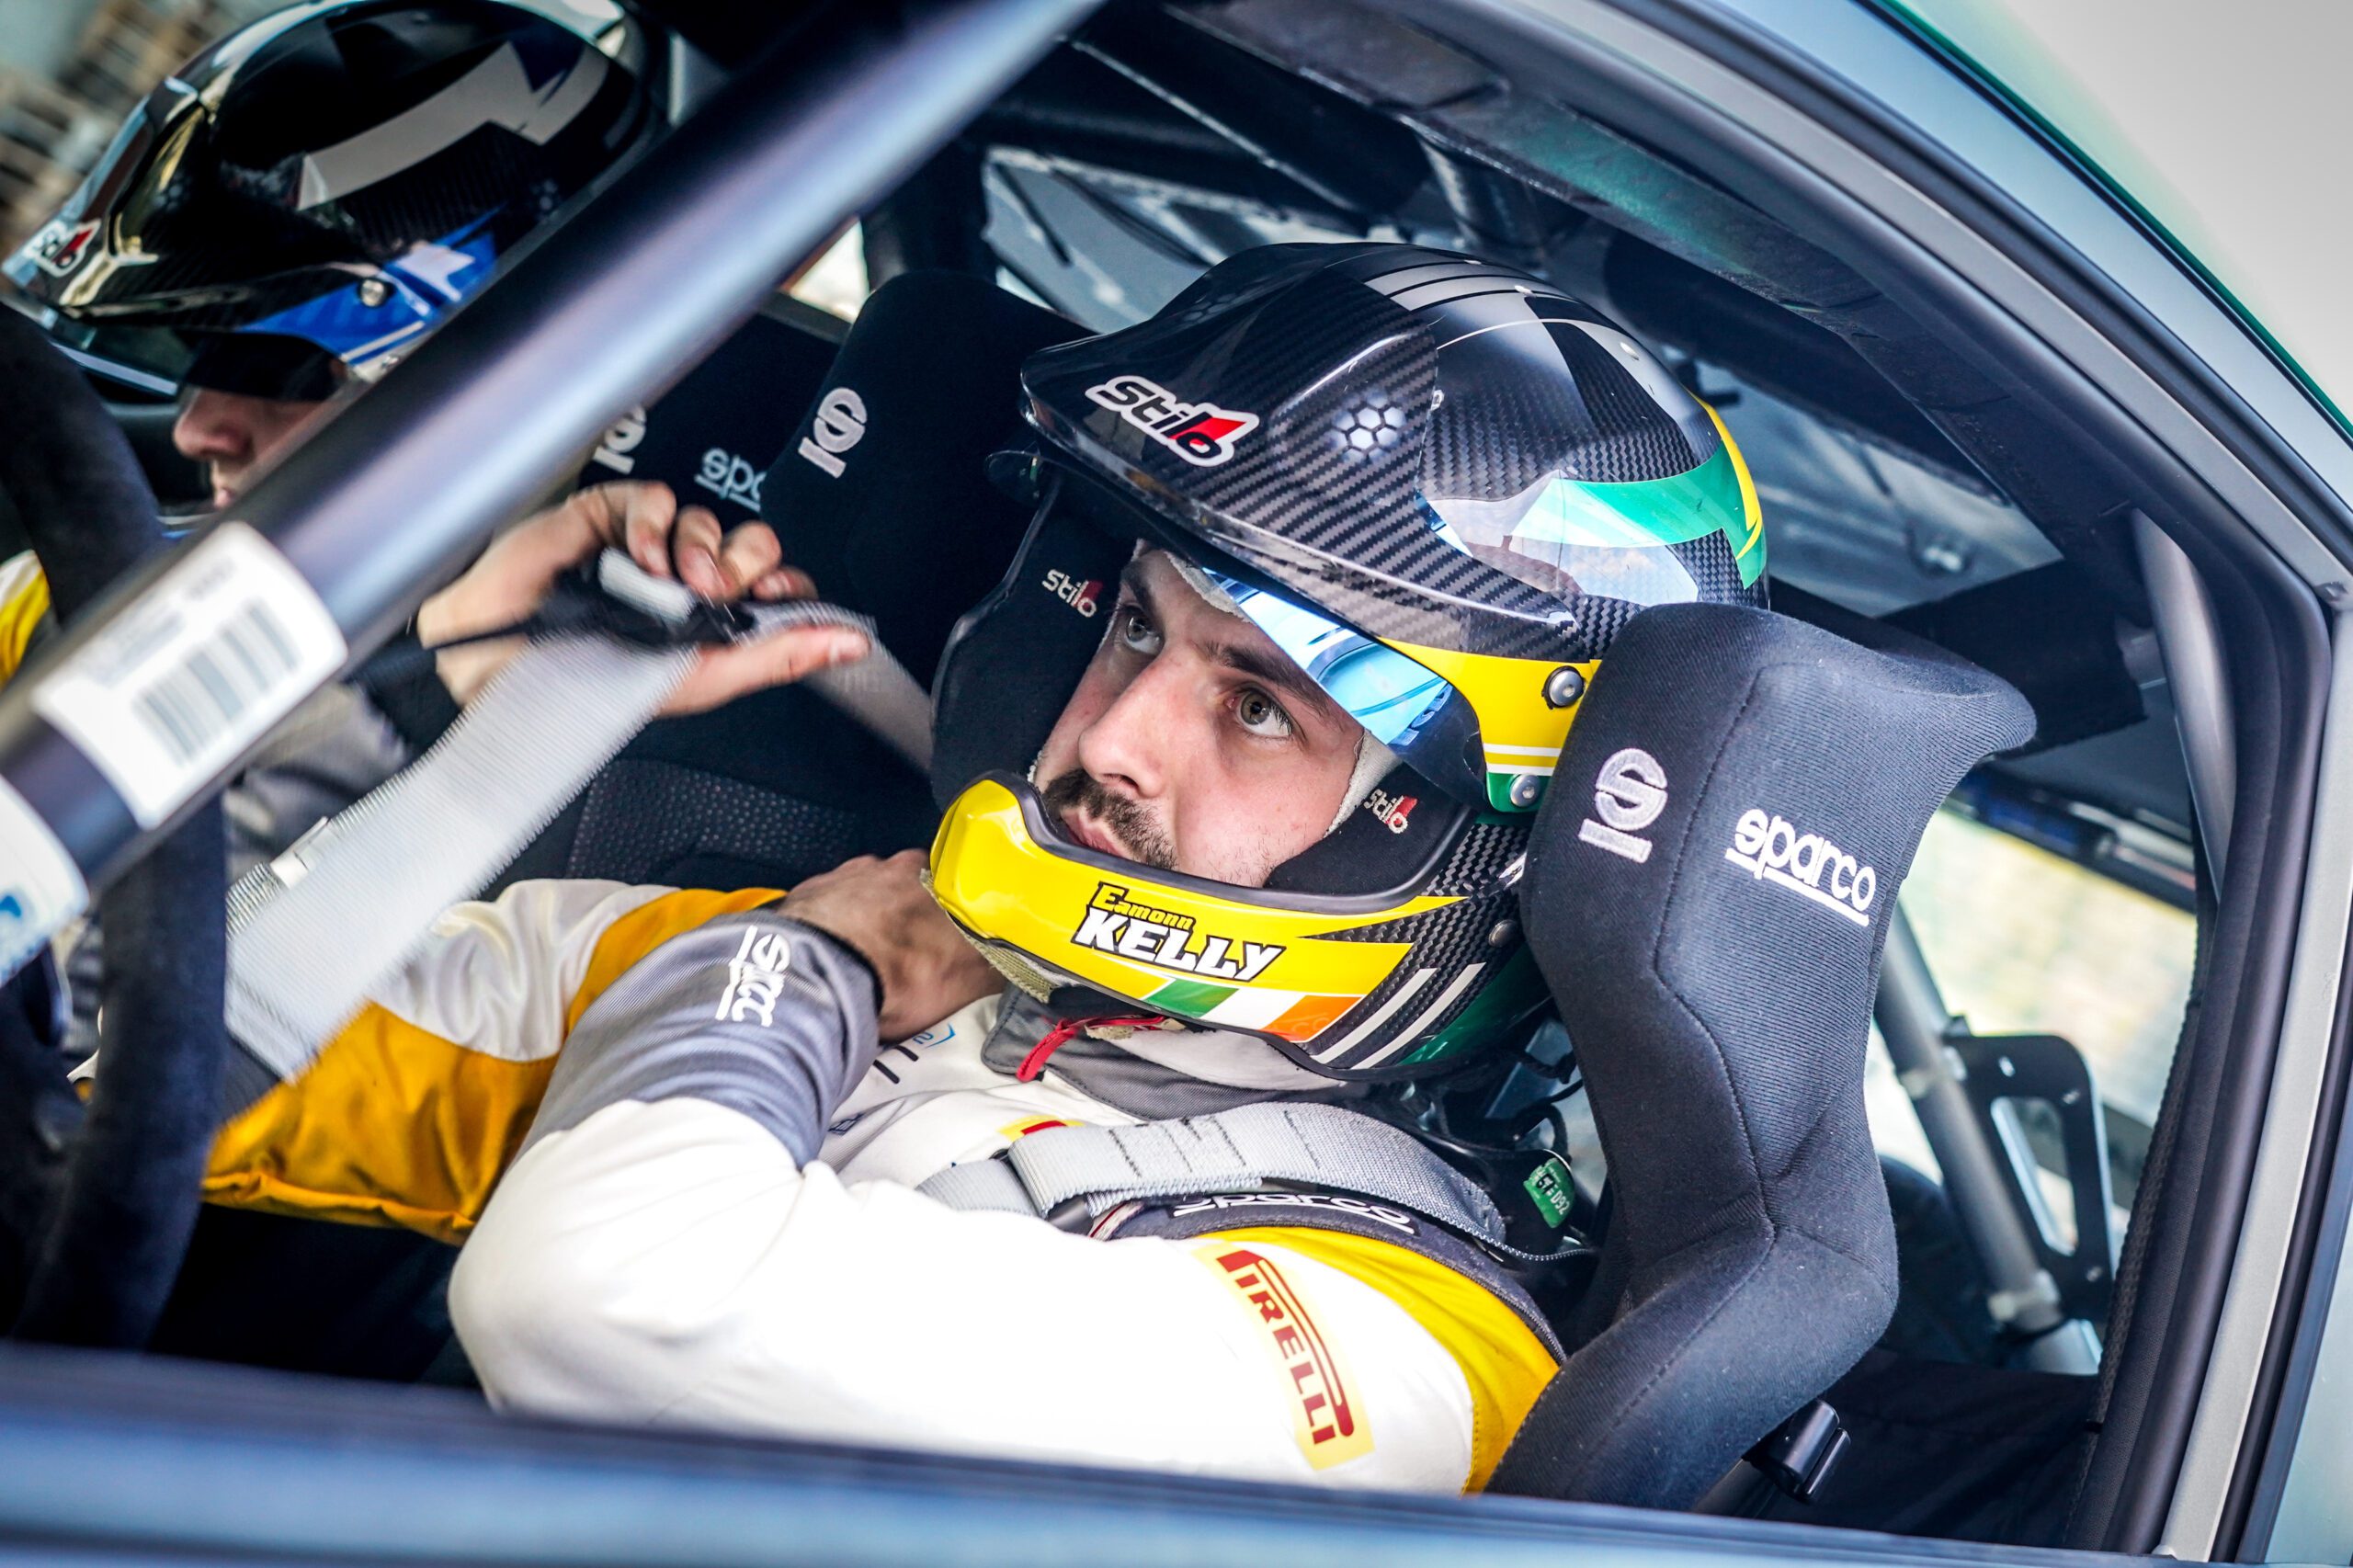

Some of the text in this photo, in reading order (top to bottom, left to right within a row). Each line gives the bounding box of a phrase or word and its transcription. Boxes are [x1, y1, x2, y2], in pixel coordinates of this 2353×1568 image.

[1091, 881, 1196, 931] Eamonn
[1733, 809, 1877, 913] sparco
[1071, 904, 1287, 983] KELLY
[1216, 1249, 1355, 1445] PIRELLI
